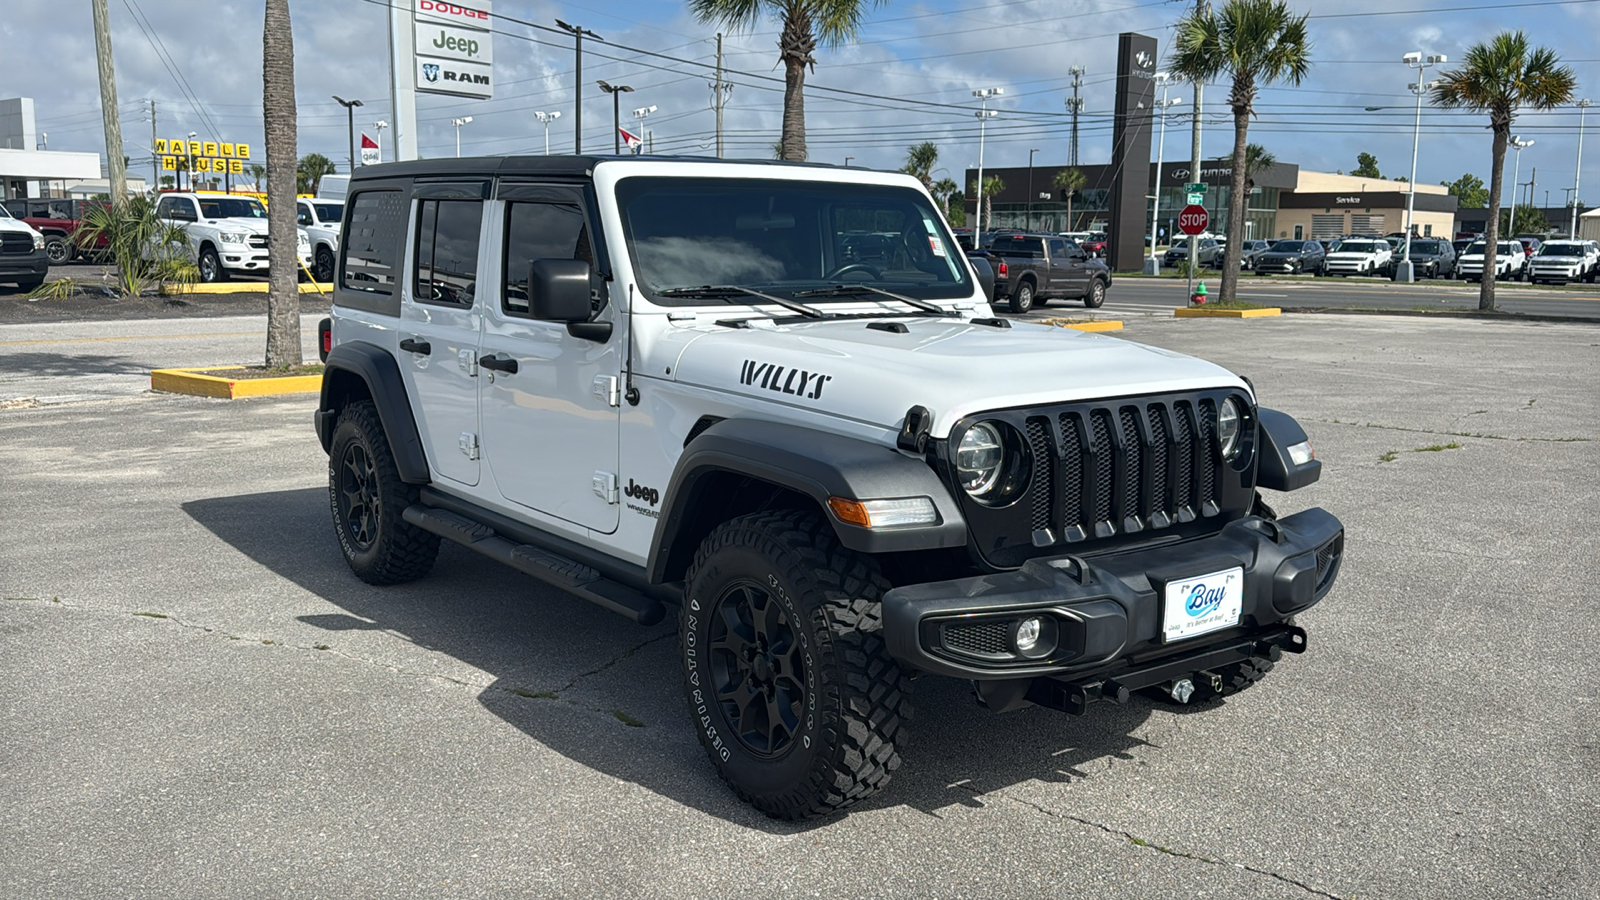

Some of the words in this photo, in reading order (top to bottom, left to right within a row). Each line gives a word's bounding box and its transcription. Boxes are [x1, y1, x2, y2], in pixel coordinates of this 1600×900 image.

[420, 0, 489, 20] DODGE
[433, 30, 479, 57] Jeep
[443, 70, 490, 86] RAM
[156, 141, 248, 156] WAFFLE
[1180, 213, 1207, 227] STOP
[740, 359, 832, 400] WILLYS
[624, 478, 659, 507] Jeep
[1189, 583, 1227, 611] Bay
[687, 614, 731, 762] DESTINATION
